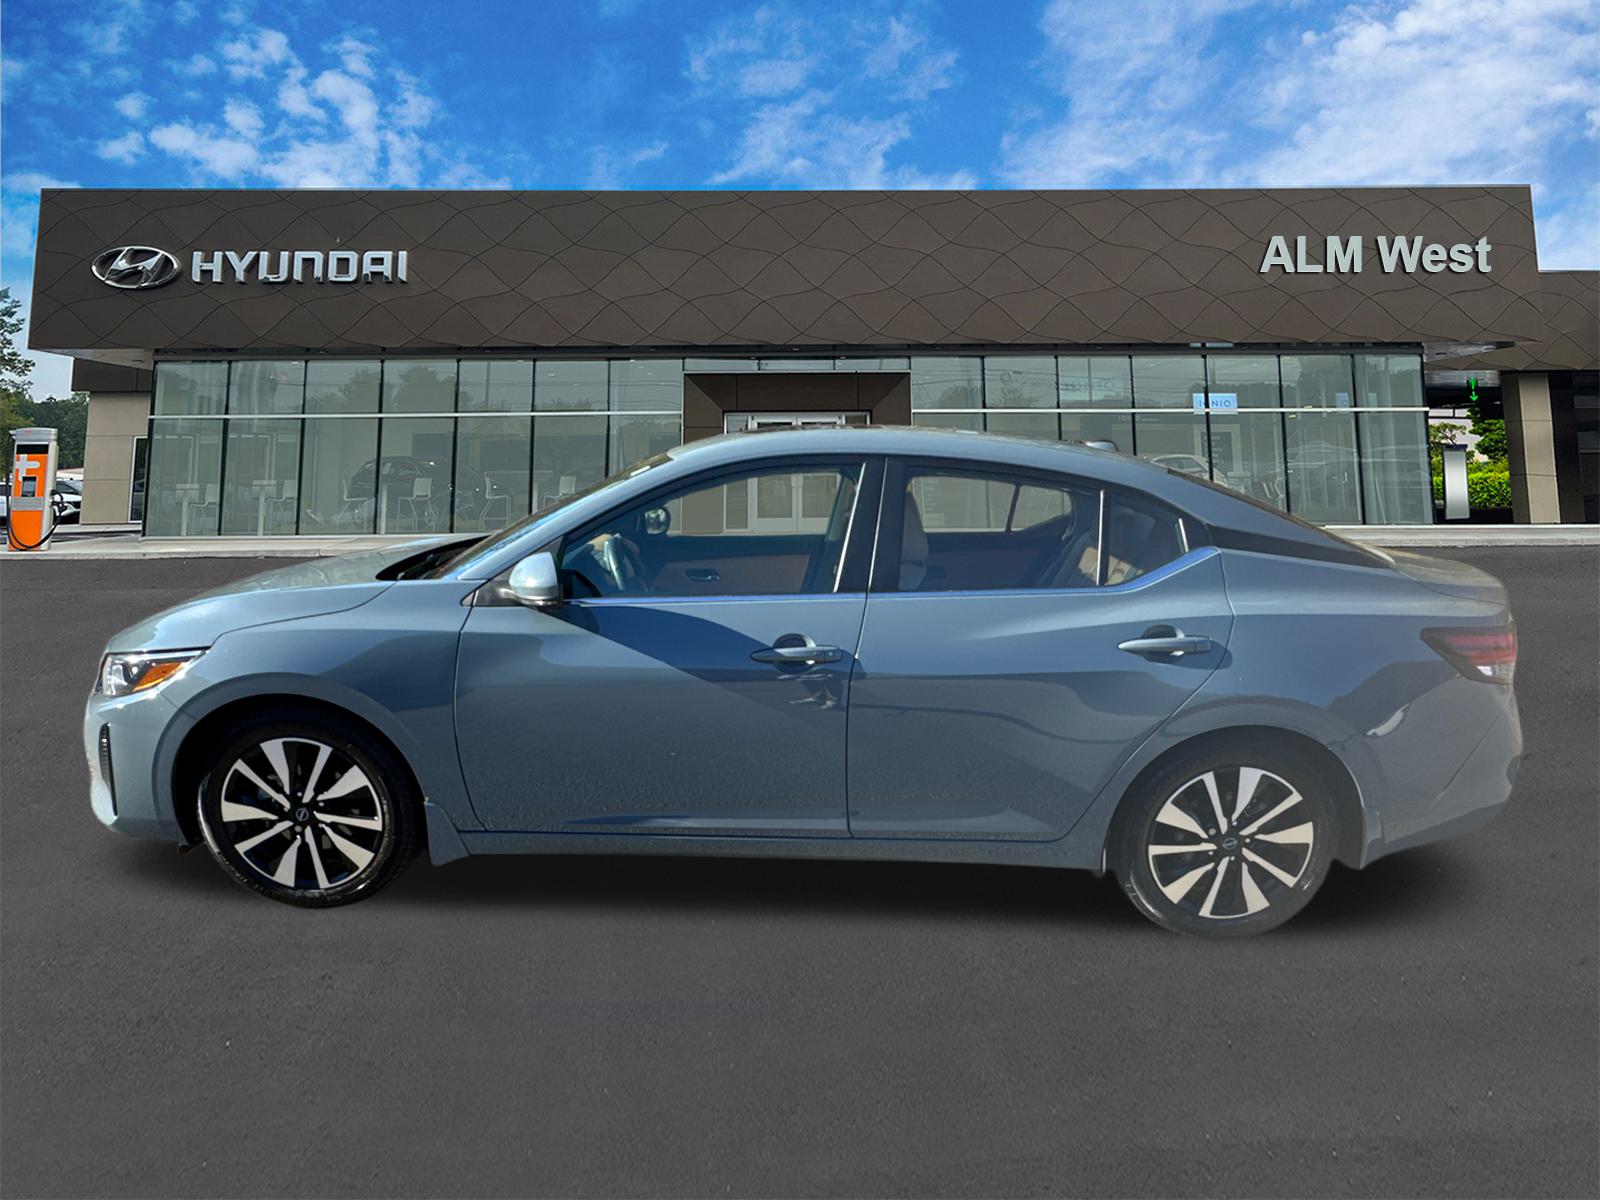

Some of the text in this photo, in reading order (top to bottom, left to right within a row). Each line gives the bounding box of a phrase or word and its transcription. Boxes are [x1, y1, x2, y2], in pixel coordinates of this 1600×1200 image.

[191, 250, 408, 283] HYUNDAI
[1260, 235, 1492, 273] ALM West
